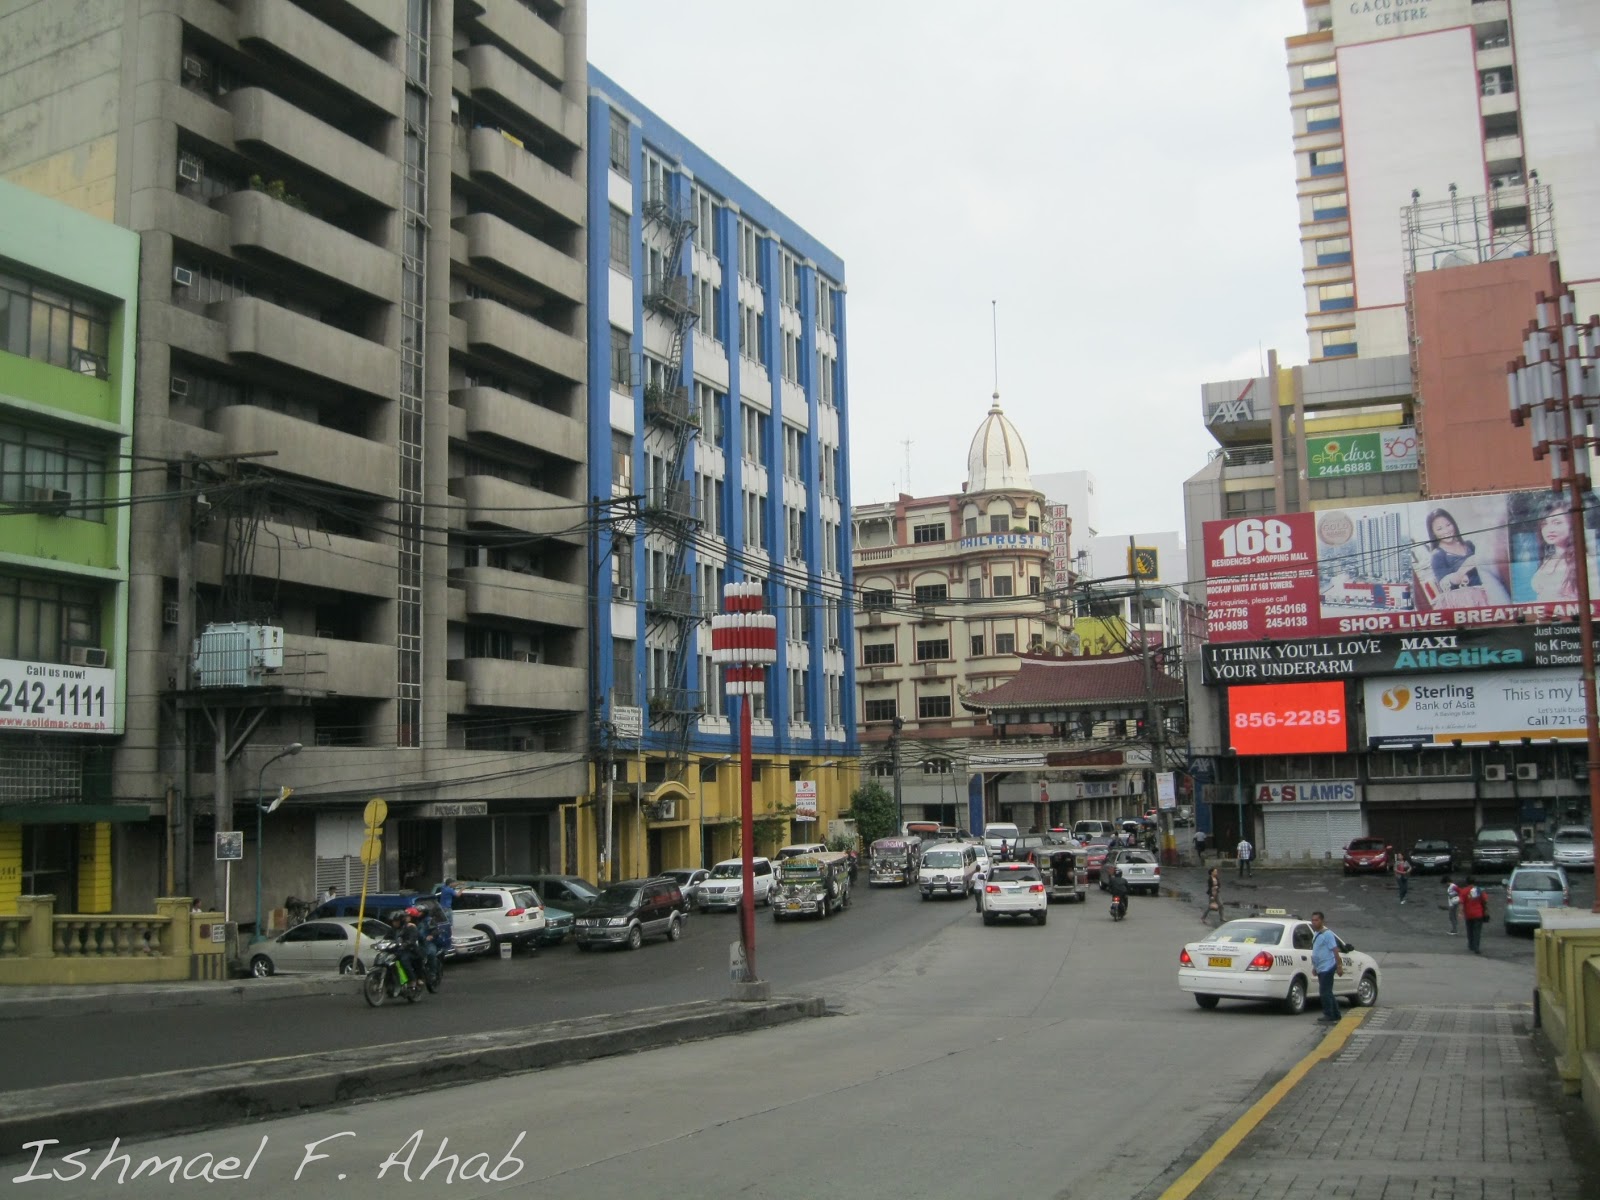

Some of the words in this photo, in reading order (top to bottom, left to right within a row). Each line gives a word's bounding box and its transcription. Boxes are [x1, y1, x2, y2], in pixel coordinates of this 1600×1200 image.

[1375, 7, 1427, 25] CENTRE
[1208, 400, 1253, 424] AXA
[1320, 462, 1371, 475] 244-6888
[960, 534, 1035, 549] PHILTRUST
[1219, 518, 1292, 557] 168
[1212, 558, 1251, 567] RESIDENCES
[1256, 554, 1290, 564] SHOPPING
[1290, 552, 1308, 561] MALL
[1250, 572, 1268, 581] PLAZA
[1207, 585, 1231, 594] MOCK-UP
[1233, 584, 1249, 592] UNITS
[1250, 583, 1257, 591] AT
[1259, 582, 1268, 590] 168
[1220, 598, 1249, 607] inquiries,
[1252, 597, 1274, 605] please
[1265, 603, 1307, 615] 245-0168
[1208, 607, 1248, 619] 247-7796
[1208, 620, 1248, 632] 310-9898
[1266, 616, 1307, 628] 245-0138
[1339, 616, 1393, 632] SHOP.
[1399, 612, 1447, 628] LIVE.
[1534, 627, 1551, 636] Just
[1212, 649, 1217, 661] I
[1221, 647, 1272, 661] THINK
[1276, 643, 1334, 658] YOU'LL
[1338, 639, 1382, 655] LOVE
[1400, 635, 1458, 650] MAXI
[1535, 642, 1547, 651] No
[1550, 639, 1559, 650] K
[1393, 646, 1523, 669] Atletika
[1536, 656, 1548, 664] No
[1551, 654, 1582, 664] Deodor
[27, 665, 46, 676] Call
[49, 669, 60, 677] us
[63, 670, 86, 679] now!
[1213, 664, 1257, 679] YOUR
[1261, 660, 1353, 677] UNDERARM
[0, 678, 105, 717] 242-1111
[1415, 684, 1474, 699] Sterling
[1502, 688, 1530, 701] This
[1534, 687, 1544, 699] is
[1549, 687, 1573, 702] my
[1416, 701, 1440, 711] Bank
[1443, 700, 1452, 709] of
[1456, 700, 1475, 709] Asia
[1235, 709, 1341, 728] 856-2285
[1527, 716, 1548, 726] Call
[1552, 715, 1587, 725] 721-6
[1300, 784, 1354, 801] LAMPS
